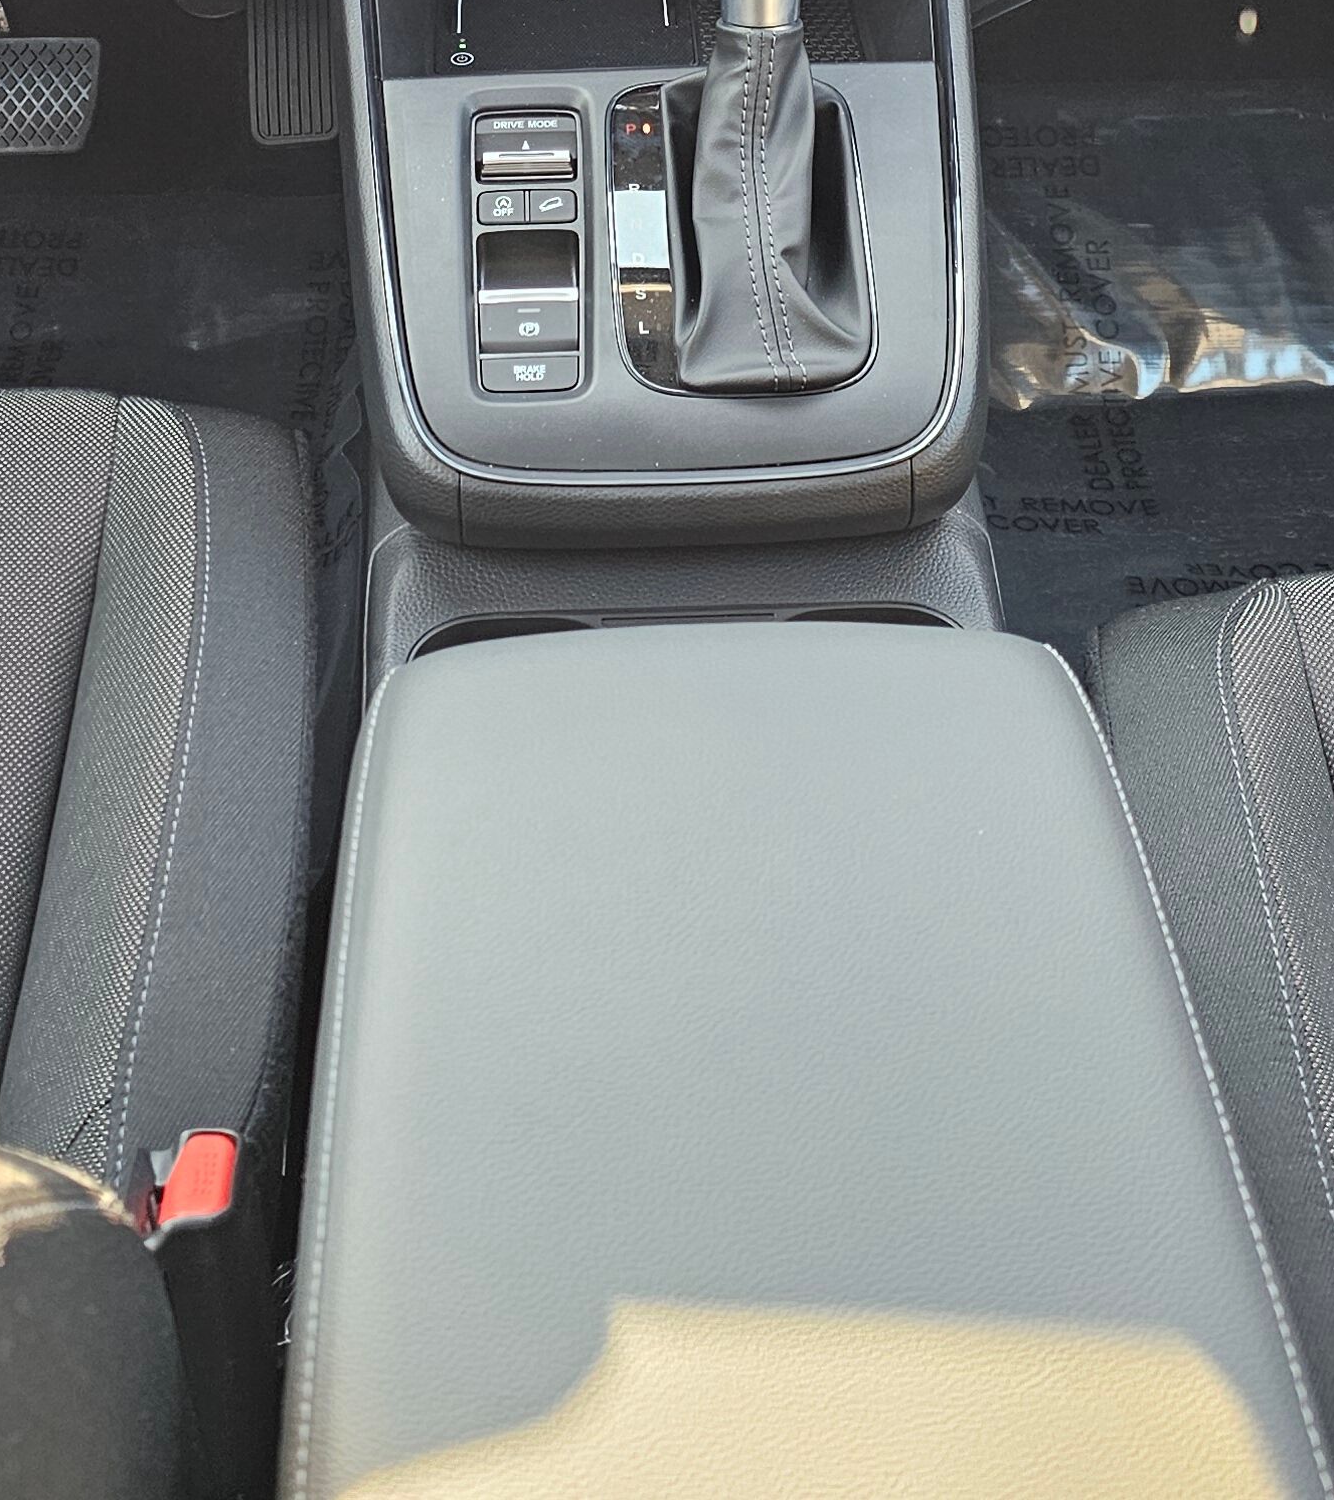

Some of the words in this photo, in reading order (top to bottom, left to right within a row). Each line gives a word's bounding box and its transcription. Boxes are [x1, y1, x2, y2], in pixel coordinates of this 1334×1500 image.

[493, 120, 524, 130] DRIVE
[527, 119, 558, 129] MODE
[625, 123, 637, 135] P
[987, 156, 1101, 178] DEALER
[492, 208, 515, 217] OFF
[632, 252, 645, 264] D
[635, 289, 647, 300] S
[1085, 239, 1121, 341] COVER
[638, 321, 650, 335] L
[513, 365, 547, 375] BRAKE
[515, 373, 545, 382] HOLD
[1069, 414, 1116, 491] DEALER
[1020, 496, 1160, 516] REMOVE
[986, 513, 1104, 534] COVER
